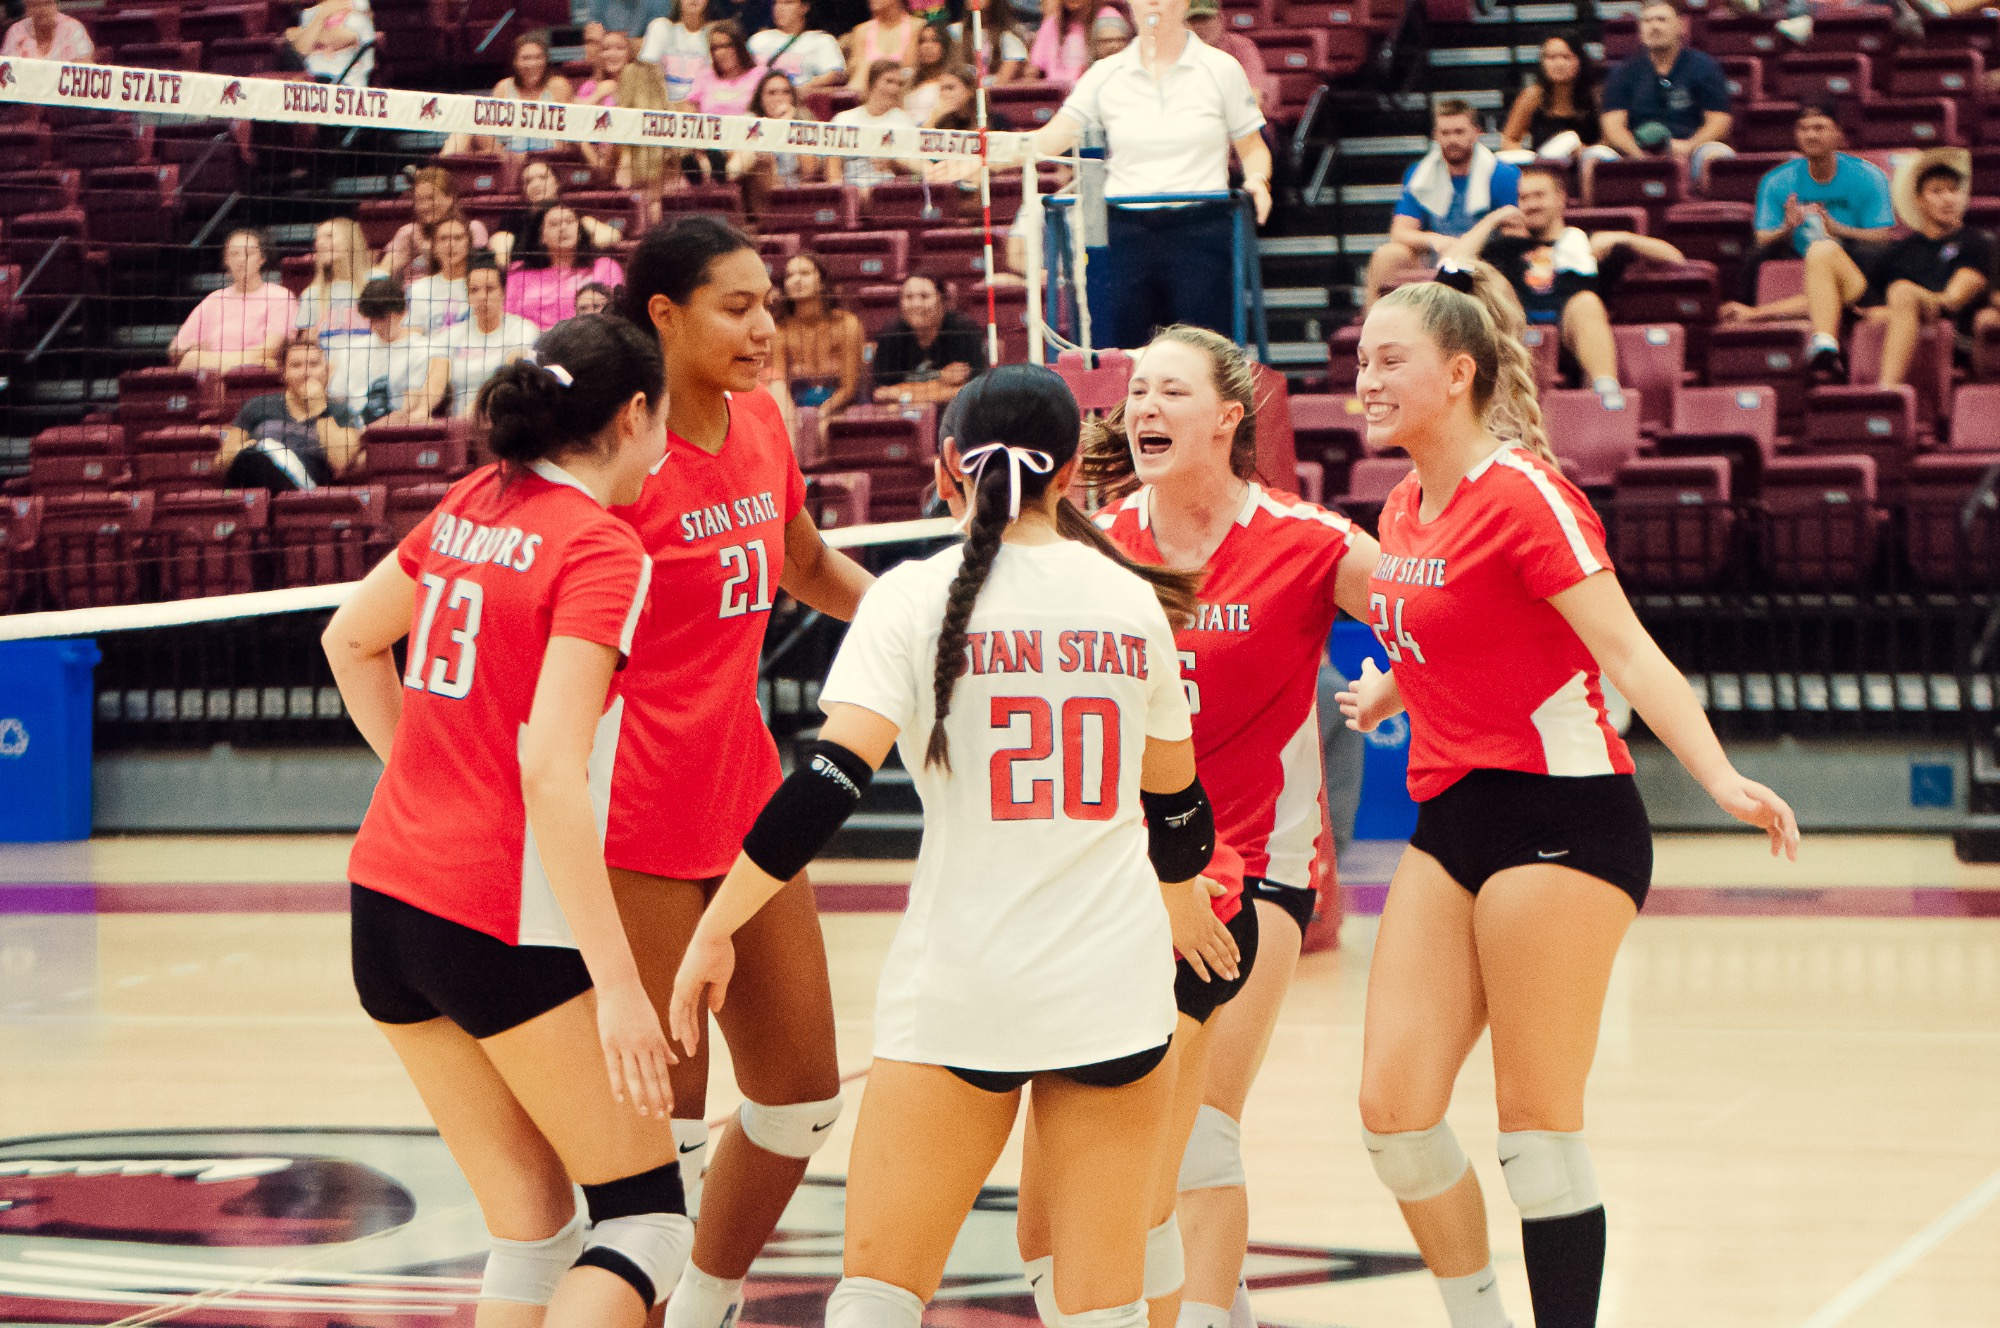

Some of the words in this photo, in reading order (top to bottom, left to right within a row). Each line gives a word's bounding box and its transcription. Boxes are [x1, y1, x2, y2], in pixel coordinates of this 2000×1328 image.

[58, 65, 112, 100] CHICO
[121, 70, 182, 104] STATE
[284, 83, 329, 113] CHICO
[335, 87, 389, 119] STATE
[474, 99, 515, 127] CHICO
[520, 102, 566, 132] STATE
[681, 113, 722, 141] STATE
[681, 510, 733, 543] STAN
[733, 491, 778, 528] STATE
[718, 539, 773, 619] 21
[1373, 552, 1404, 583] TAN
[1396, 557, 1447, 588] STATE
[403, 571, 484, 700] 13
[1369, 592, 1426, 665] 24
[958, 630, 1043, 676] TAN
[1058, 629, 1149, 682] STATE
[989, 695, 1121, 821] 20
